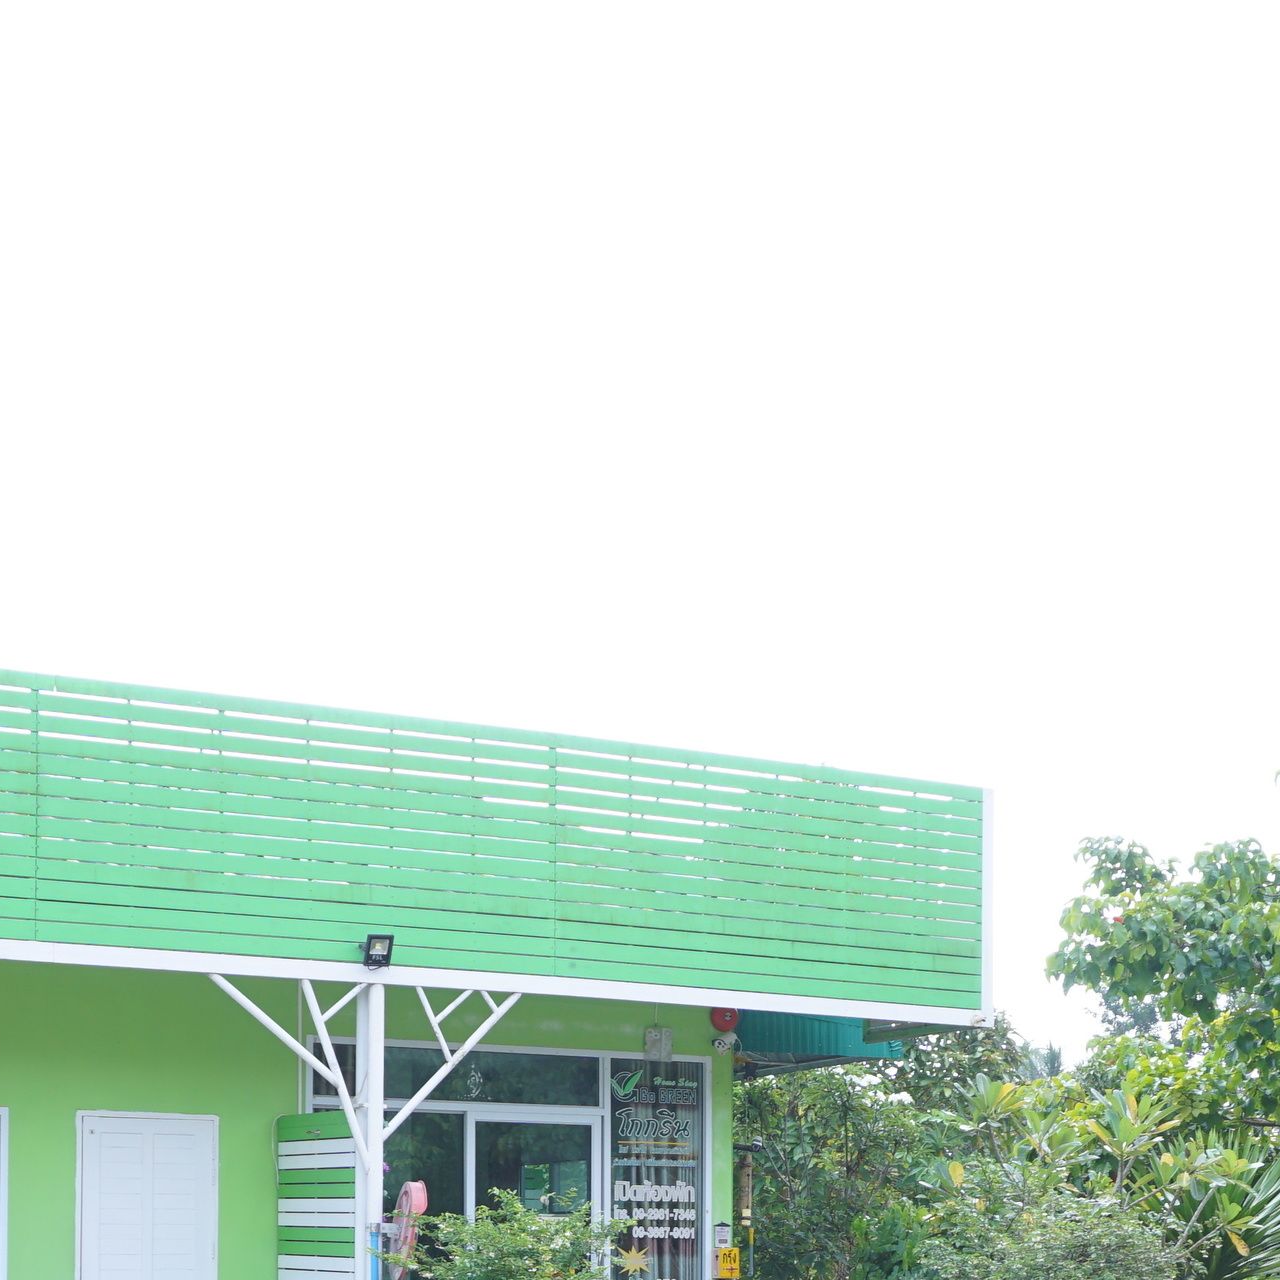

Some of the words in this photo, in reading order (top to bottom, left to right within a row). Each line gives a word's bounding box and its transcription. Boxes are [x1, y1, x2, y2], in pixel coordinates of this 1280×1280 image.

[659, 1088, 696, 1105] GREEN
[615, 1107, 690, 1138] โกกรีน
